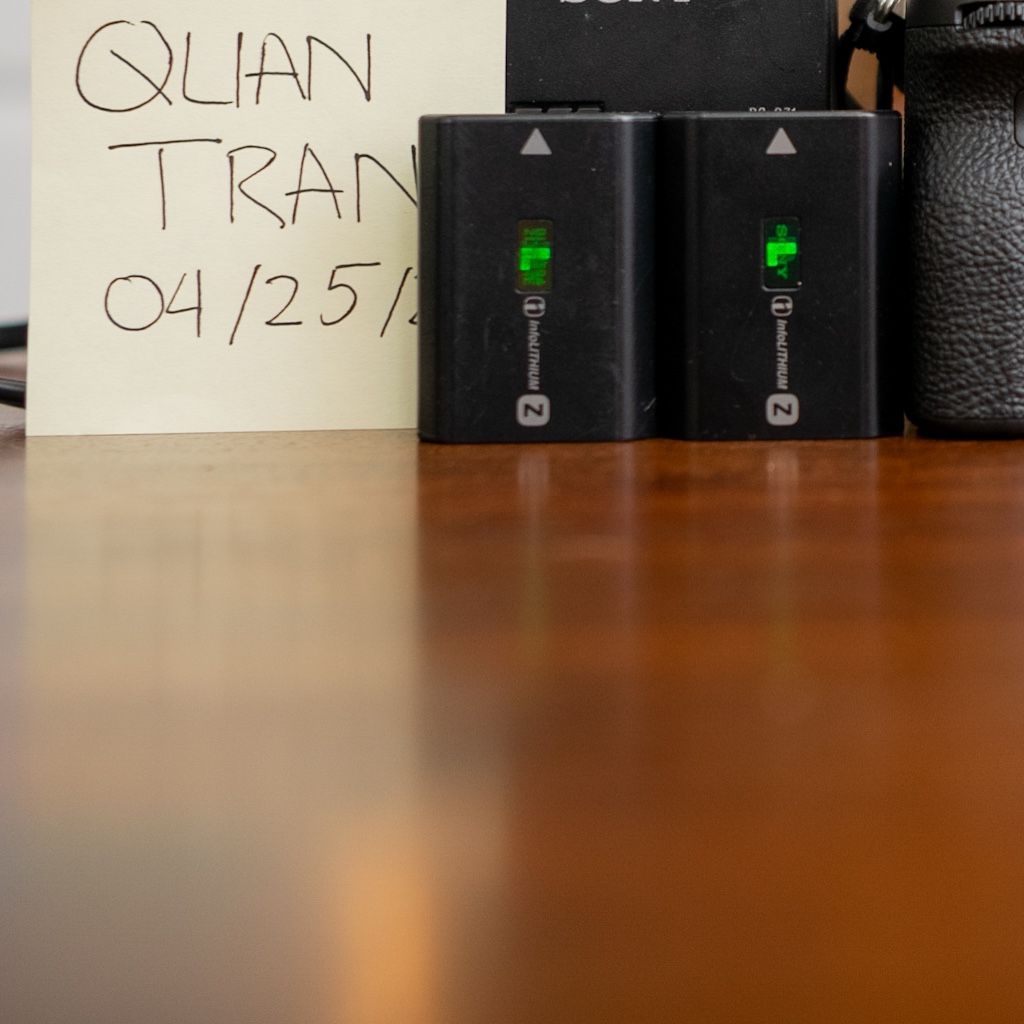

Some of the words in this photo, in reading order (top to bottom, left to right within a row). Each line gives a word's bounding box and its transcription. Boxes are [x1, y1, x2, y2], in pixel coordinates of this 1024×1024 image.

[108, 138, 416, 230] TRAN
[104, 262, 417, 345] 04/25/
[528, 319, 541, 391] InfoLITHIUM
[776, 318, 789, 390] InfoLITHIUM
